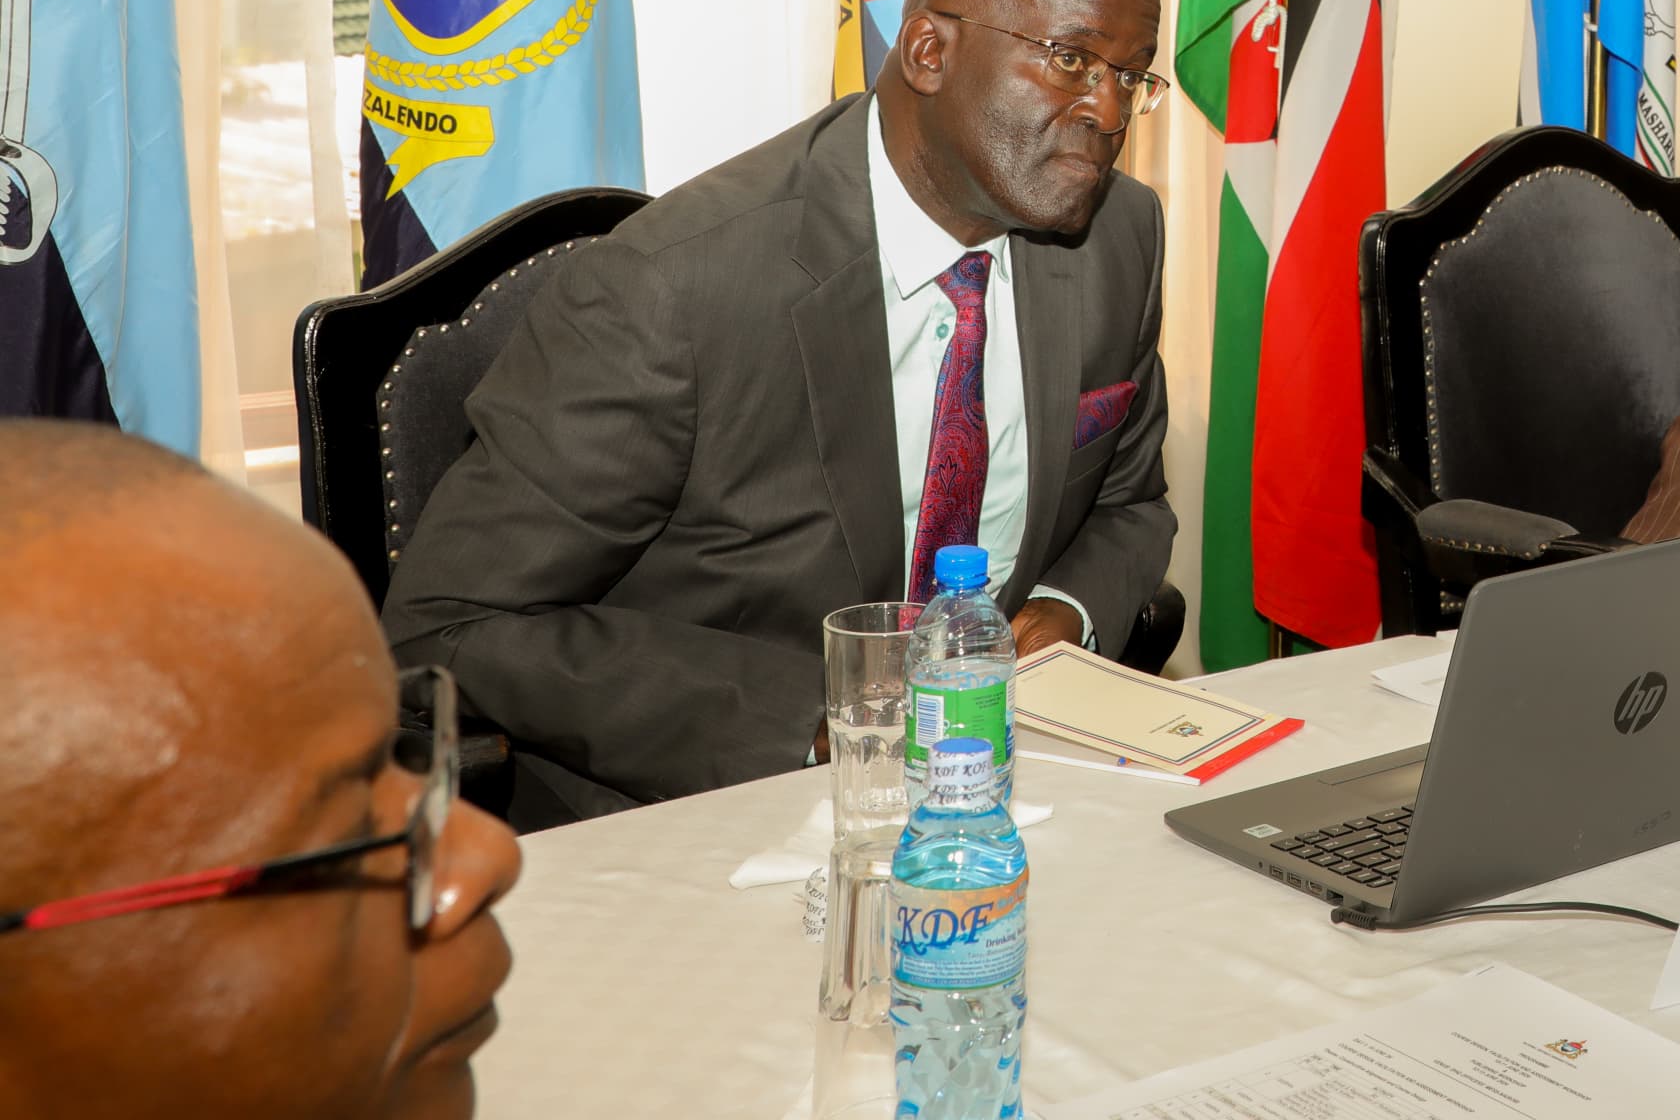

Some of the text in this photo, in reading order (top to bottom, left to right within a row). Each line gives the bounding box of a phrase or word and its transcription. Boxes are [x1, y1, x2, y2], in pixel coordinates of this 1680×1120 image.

[1614, 671, 1668, 735] hp
[897, 901, 994, 956] KDF
[985, 932, 1016, 949] Drinking
